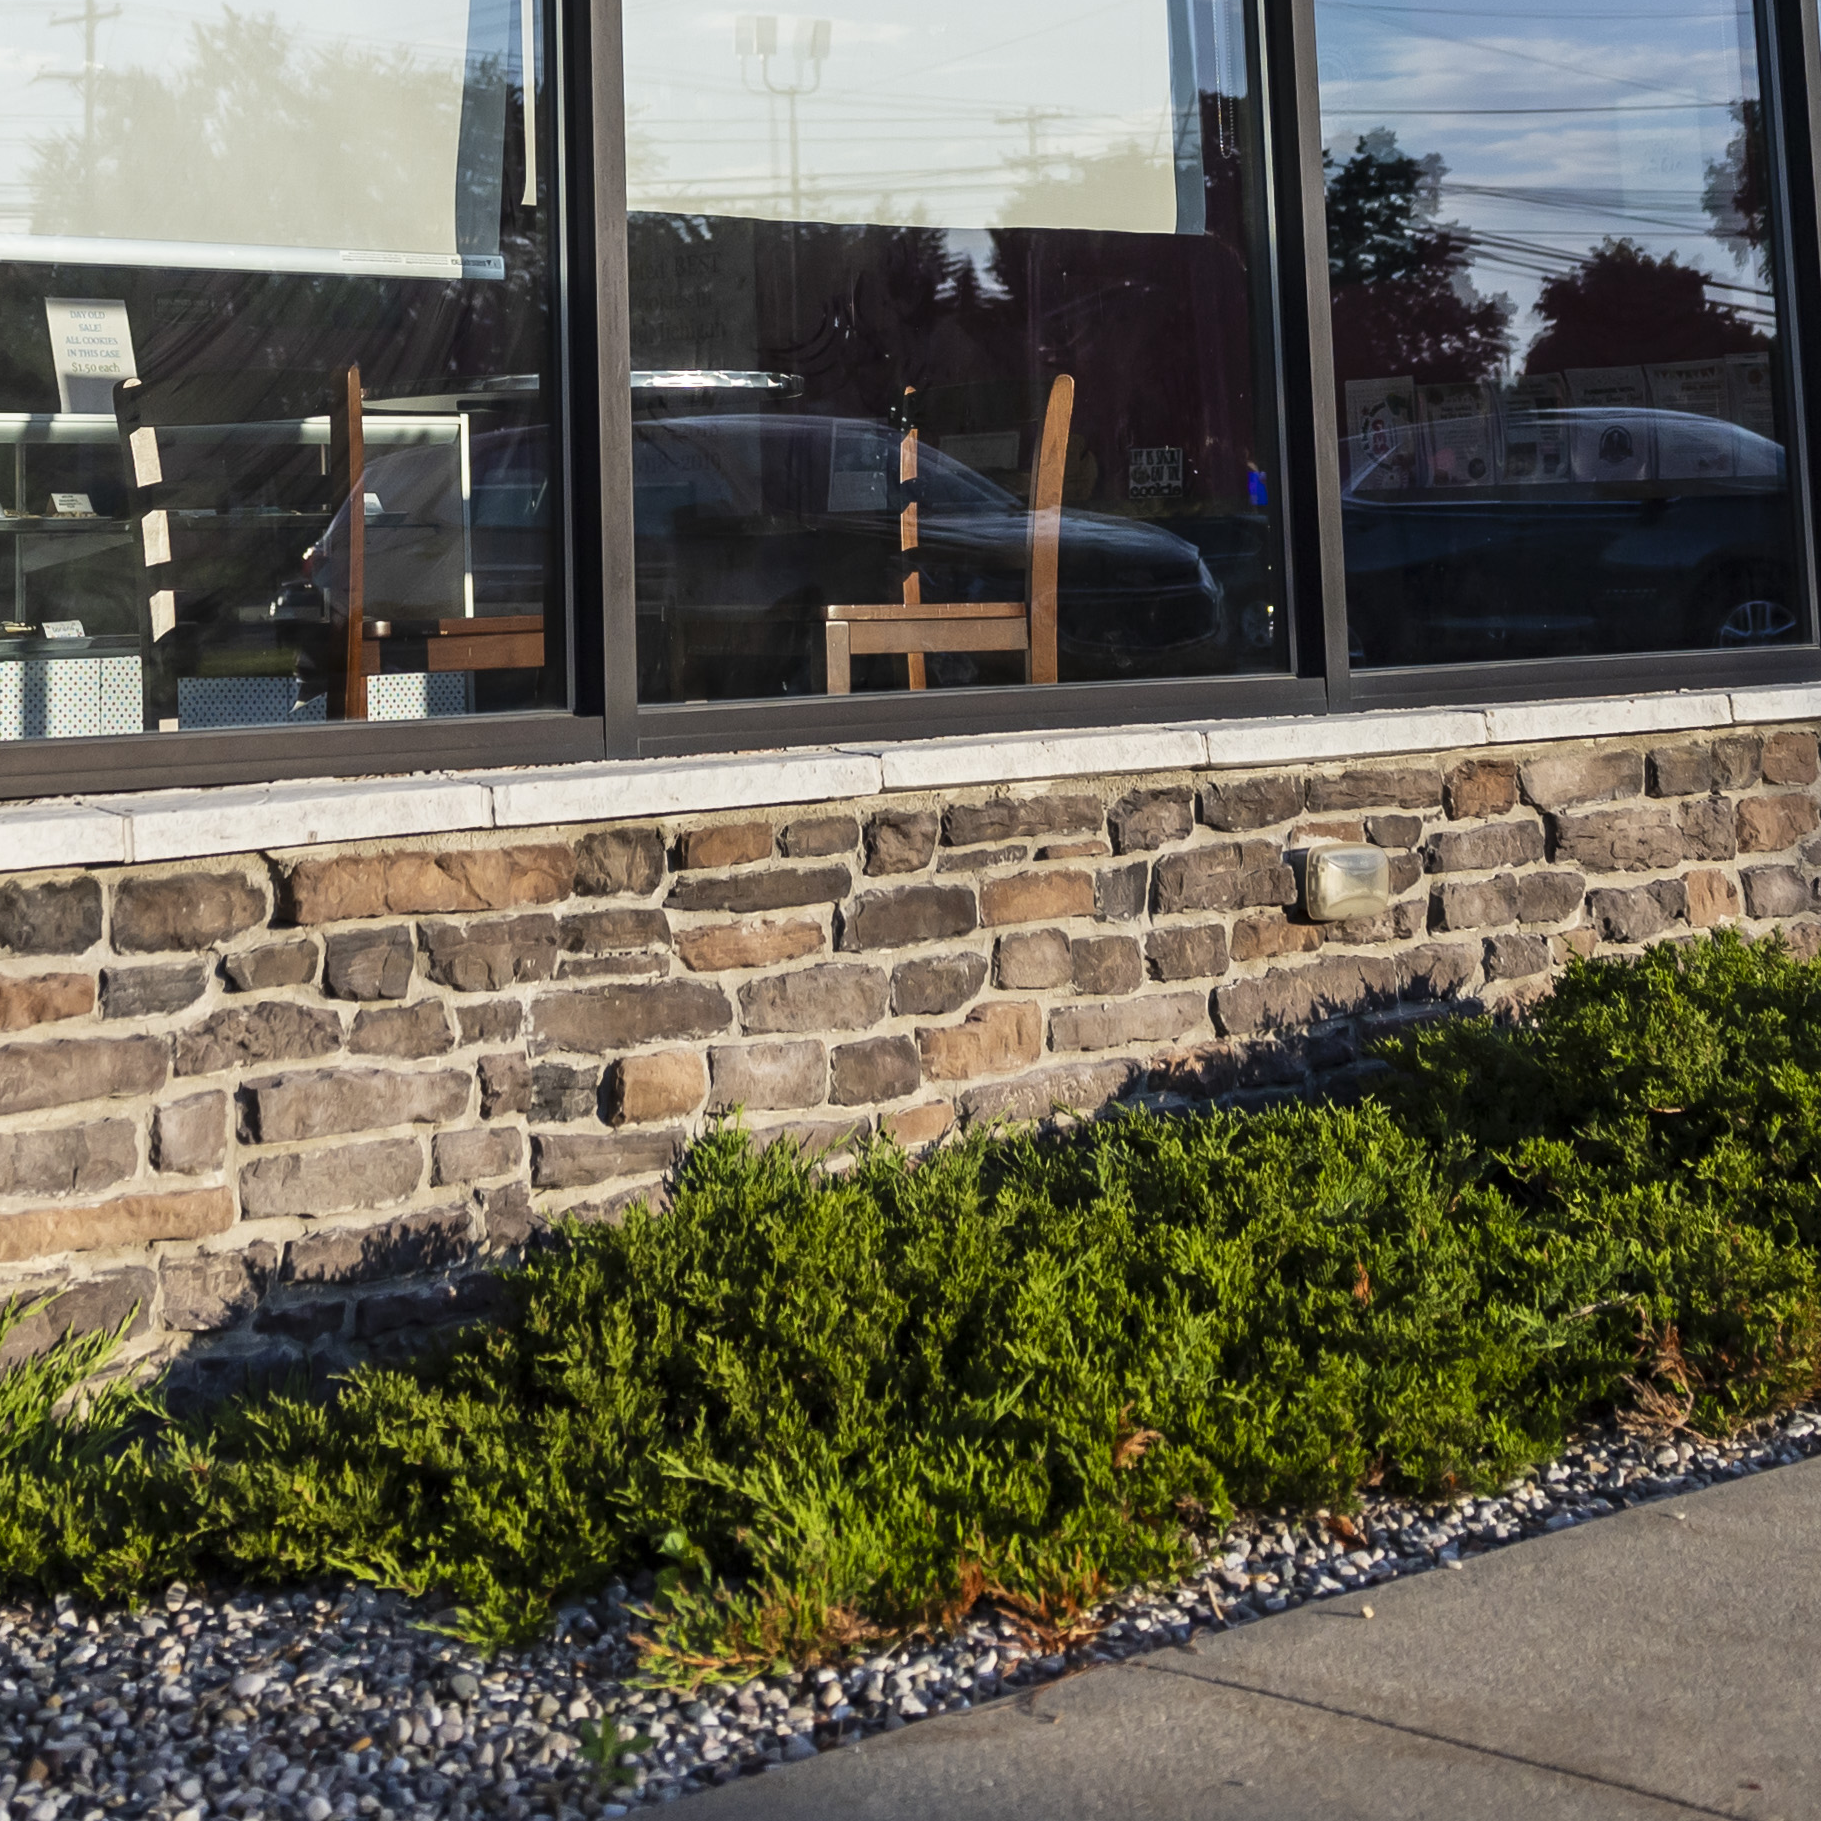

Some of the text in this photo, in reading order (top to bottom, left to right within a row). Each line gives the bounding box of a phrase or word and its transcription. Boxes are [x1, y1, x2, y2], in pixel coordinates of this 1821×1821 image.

[70, 310, 106, 320] DAY OLD
[65, 336, 118, 346] ALL COOKIES
[67, 349, 122, 359] IN THIS CASE
[72, 362, 122, 375] $1.50 each
